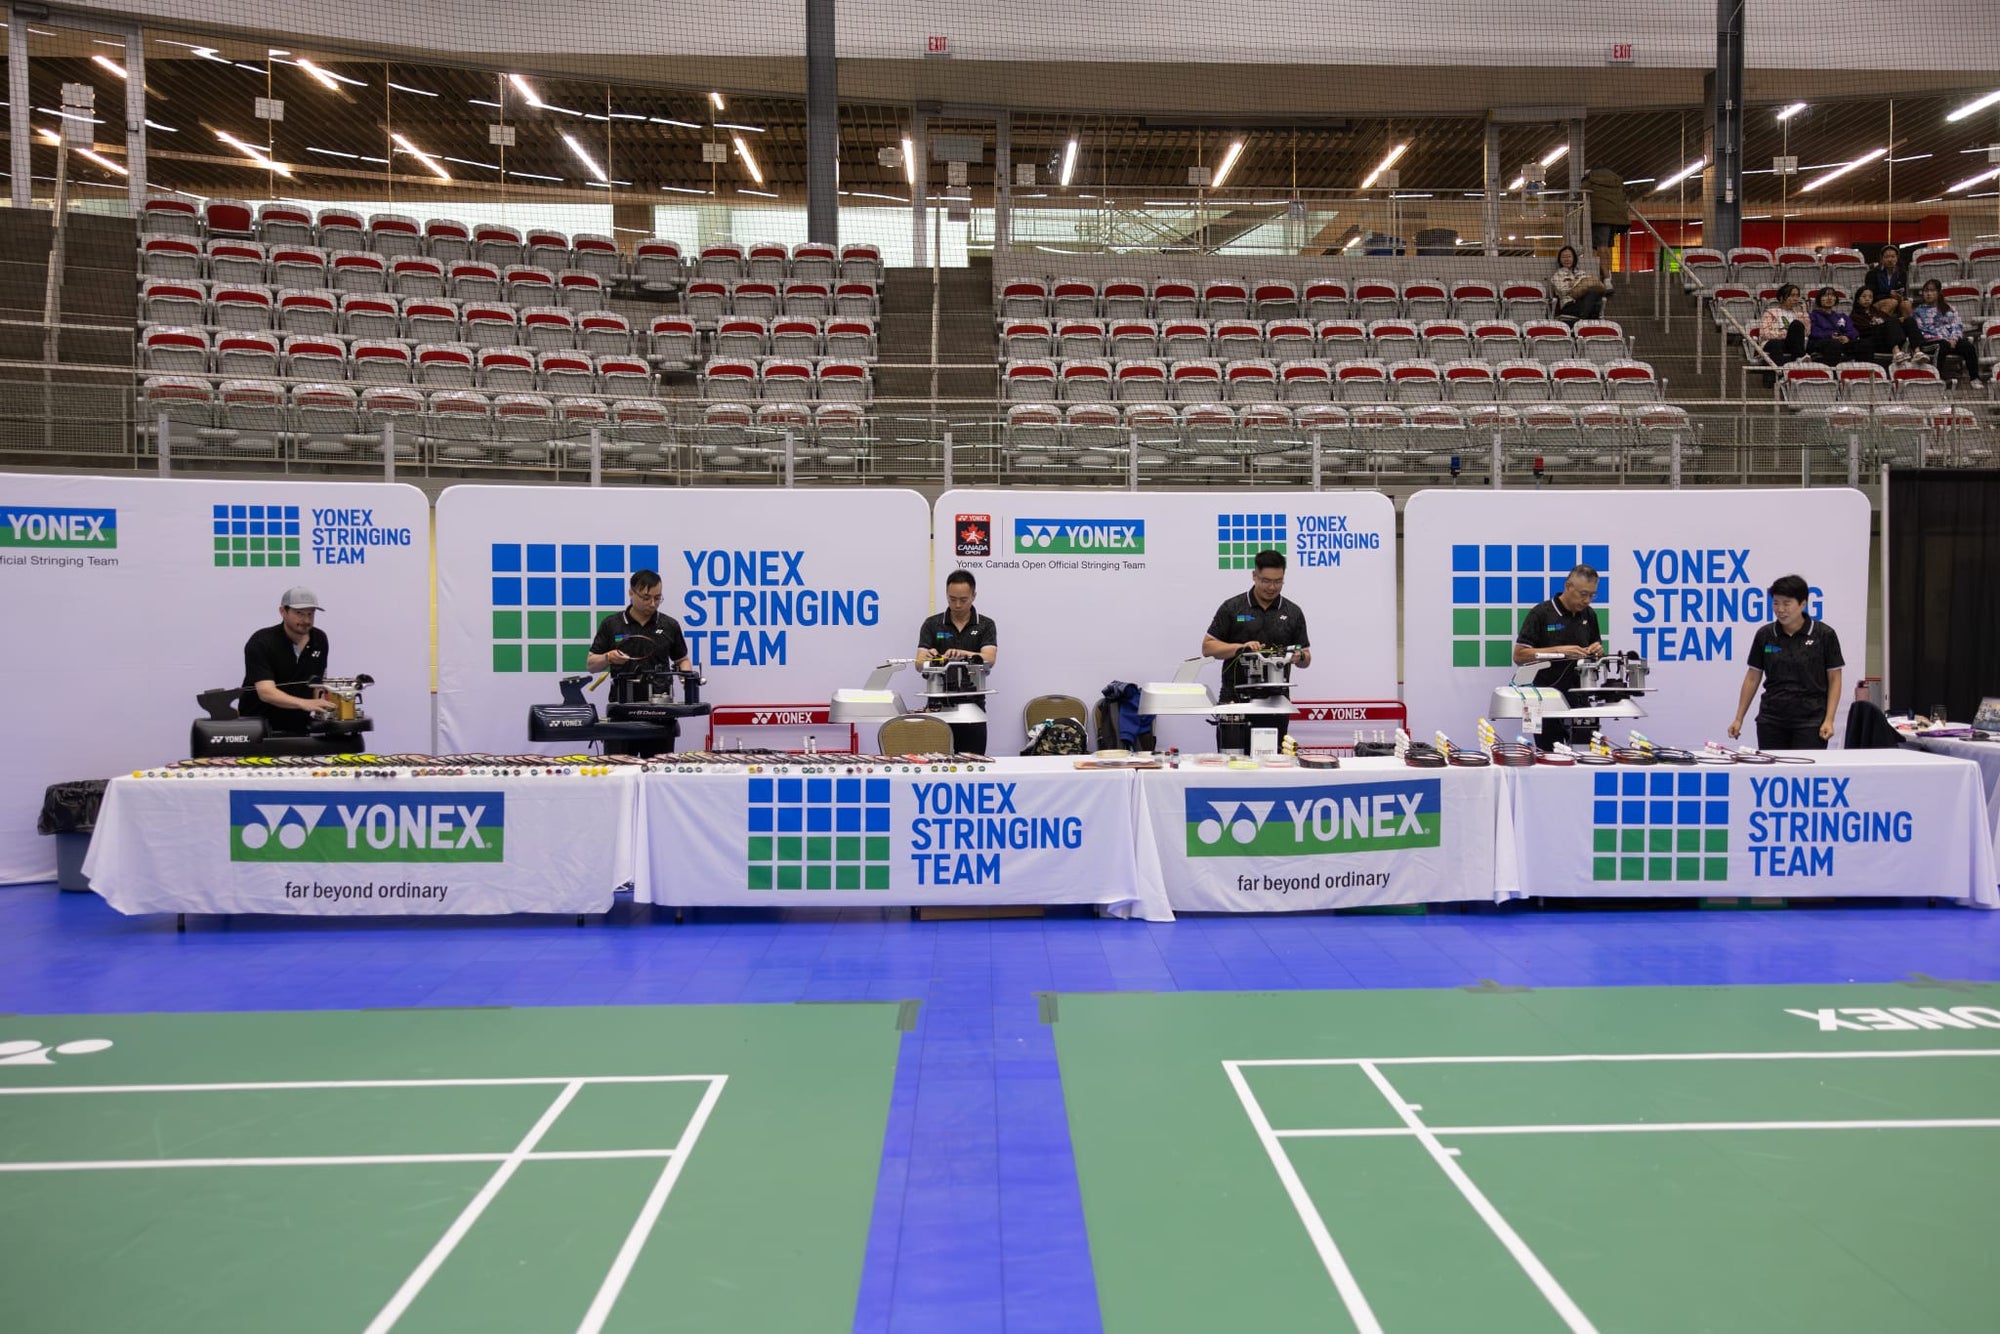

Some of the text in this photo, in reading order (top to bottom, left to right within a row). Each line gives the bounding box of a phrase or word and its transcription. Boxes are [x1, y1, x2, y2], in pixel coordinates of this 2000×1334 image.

[929, 36, 947, 51] EXIT
[1614, 44, 1632, 59] EXIT
[8, 514, 105, 541] YONEX
[313, 509, 373, 527] YONEX
[1297, 516, 1347, 532] YONEX
[312, 528, 411, 546] STRINGING
[1065, 525, 1136, 548] YONEX
[1296, 533, 1380, 549] STRINGING
[30, 555, 84, 568] Stringing
[87, 555, 119, 566] Team
[313, 547, 365, 565] TEAM
[956, 560, 1146, 571] Yonex Canada Open Official Stringing Team
[1297, 550, 1341, 567] TEAM
[1633, 549, 1750, 585] YONEX
[684, 550, 805, 587] YONEX
[684, 590, 880, 627] STRINGING
[1633, 587, 1824, 623] STRINGIG
[683, 630, 787, 667] TEAM
[1633, 627, 1733, 661] TEAM
[562, 719, 583, 728] YONEX
[775, 711, 813, 724] YONEX
[1331, 708, 1367, 720] YONEX
[225, 735, 249, 743] YONEX
[911, 782, 1017, 815] YONEX
[1749, 776, 1850, 809] YONEX
[337, 804, 486, 850] YONEX
[1284, 792, 1425, 843] YONEX
[1748, 811, 1913, 843] STRINGING
[911, 816, 1083, 851] STRINGING
[911, 853, 1001, 885] TEAM
[1748, 845, 1834, 877] TEAM
[285, 880, 448, 902] far beyond ordinary
[1237, 870, 1391, 895] far beyond ordinary
